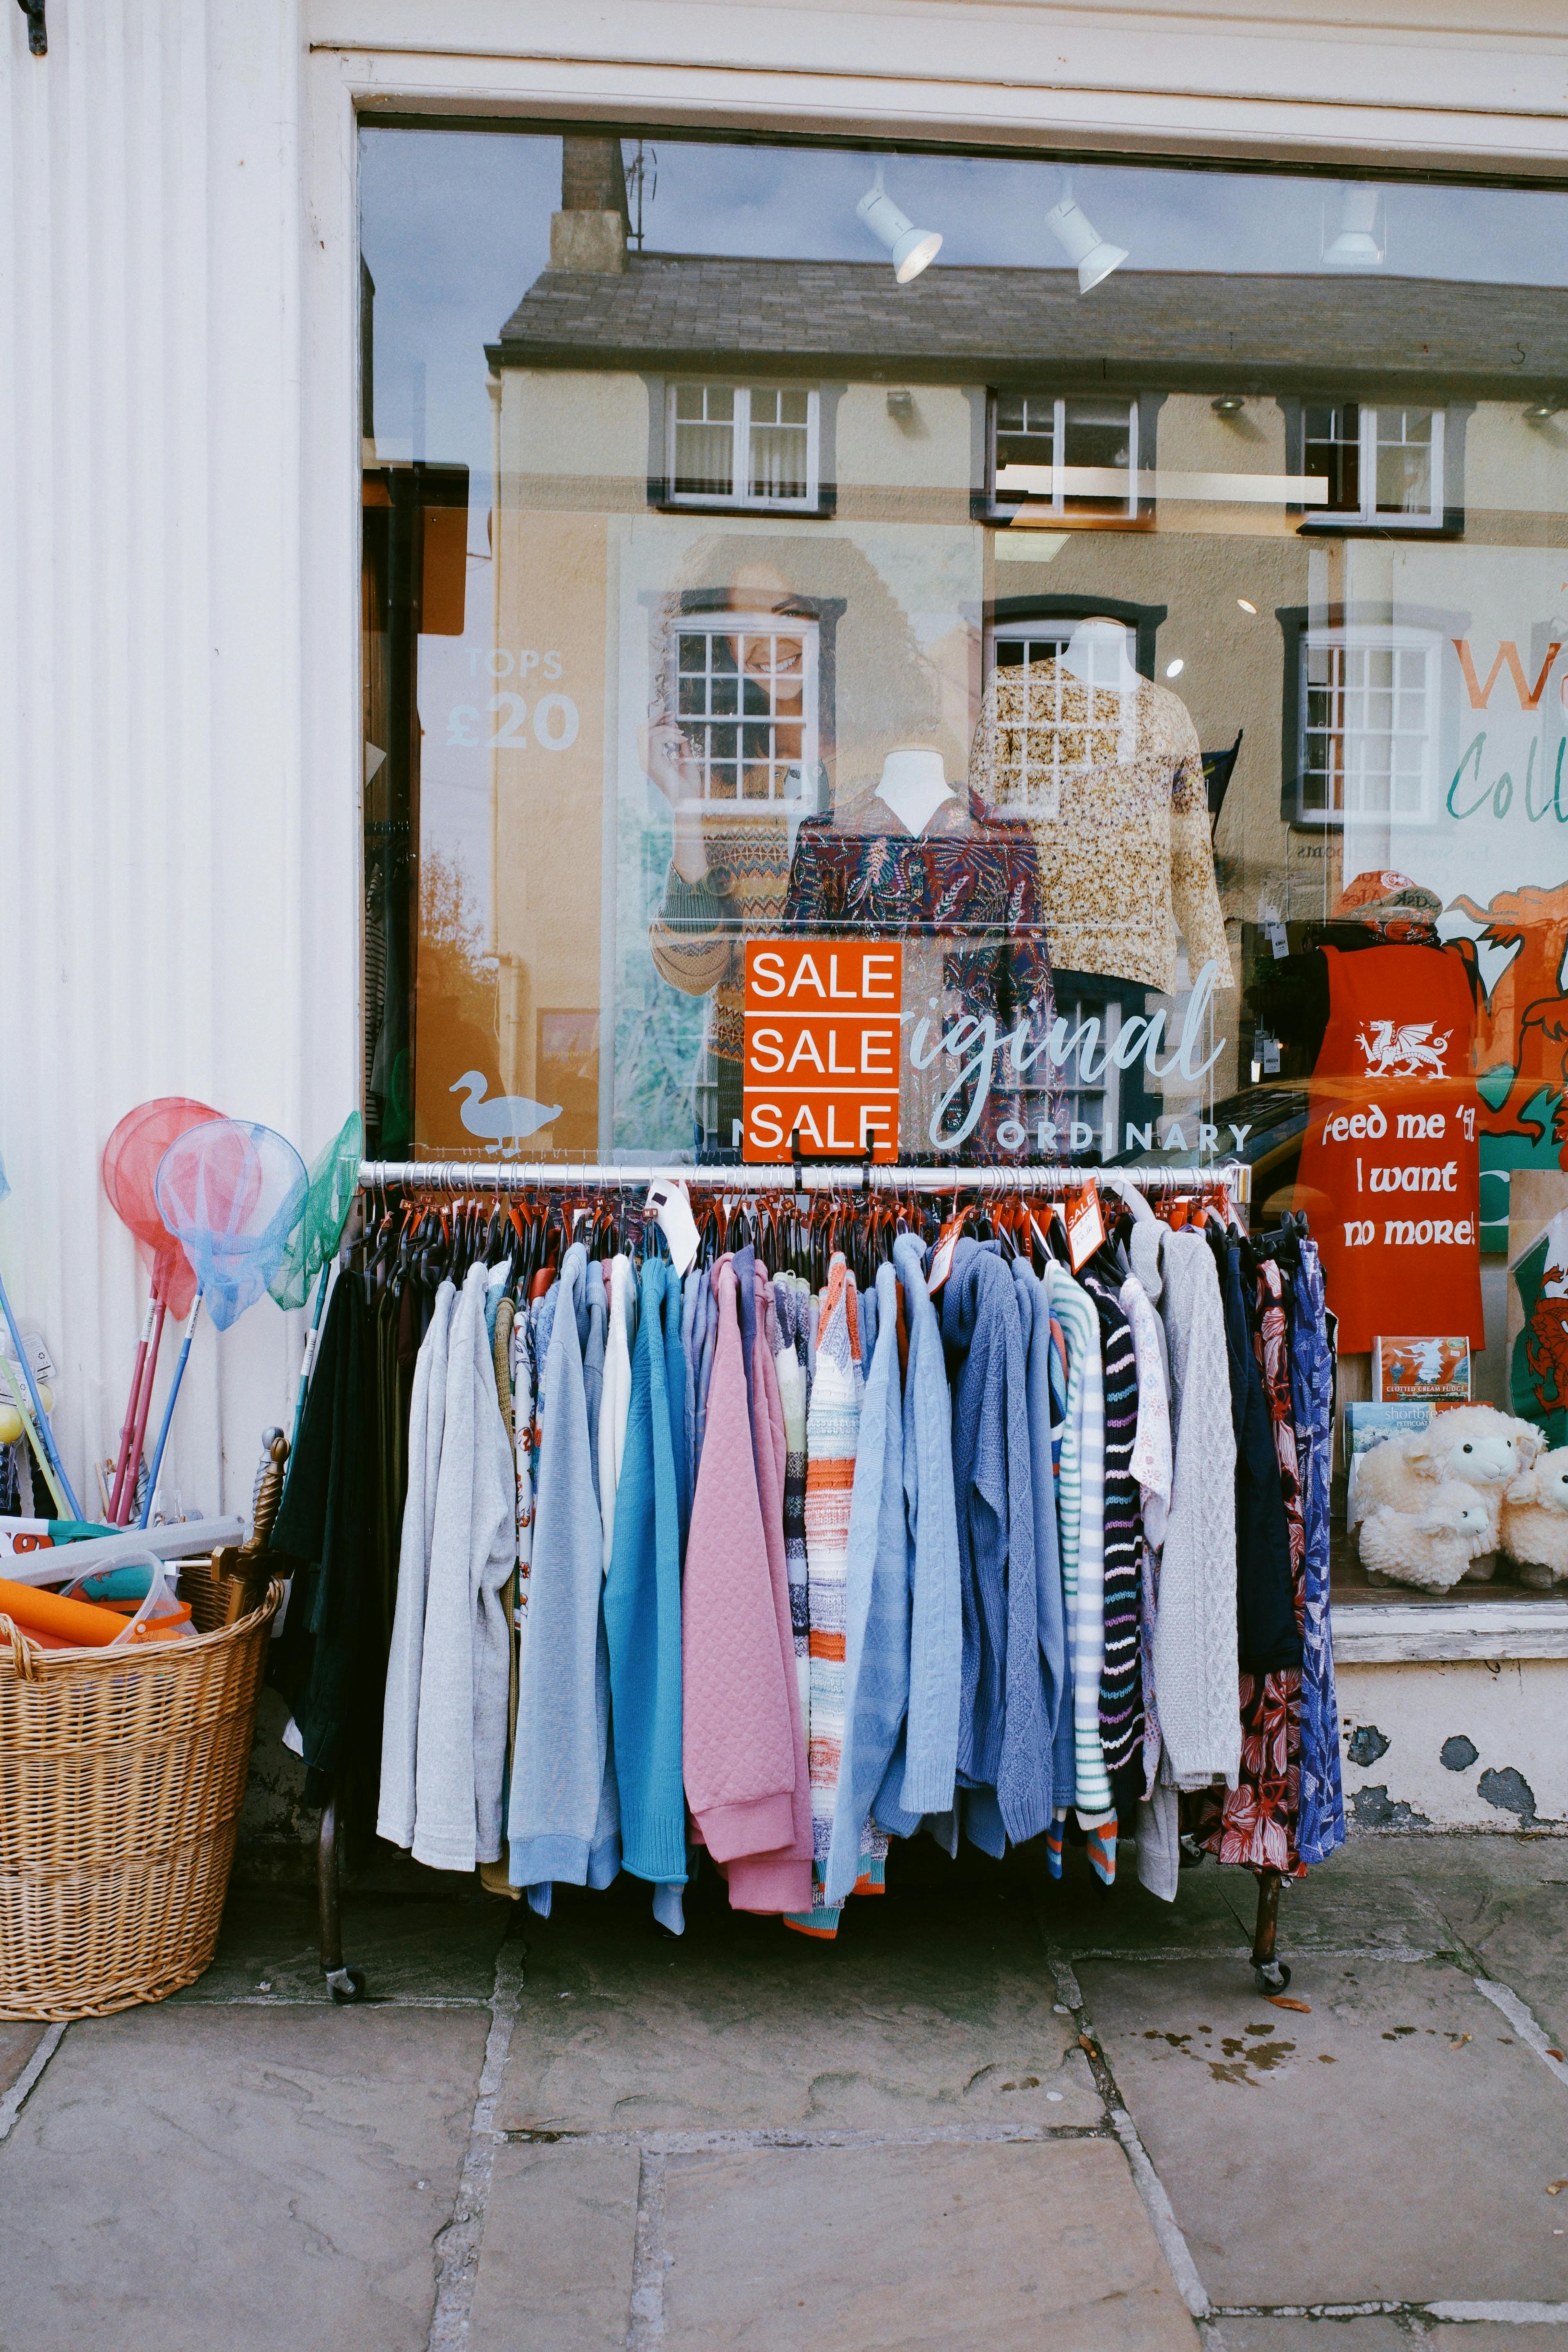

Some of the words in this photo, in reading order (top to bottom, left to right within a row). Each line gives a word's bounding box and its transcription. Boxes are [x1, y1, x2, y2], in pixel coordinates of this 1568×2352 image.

[464, 648, 562, 679] TOPS
[446, 691, 579, 751] £20
[751, 952, 895, 999] SALE
[750, 1028, 893, 1074] SALE
[901, 959, 1227, 1150] iginal
[749, 1104, 891, 1148] SALE
[996, 1120, 1253, 1152] ORDINARY
[1397, 1114, 1445, 1139] me
[1357, 1158, 1363, 1192] I
[1370, 1161, 1458, 1192] want
[1068, 1191, 1095, 1229] SALE
[1343, 1220, 1375, 1247] no
